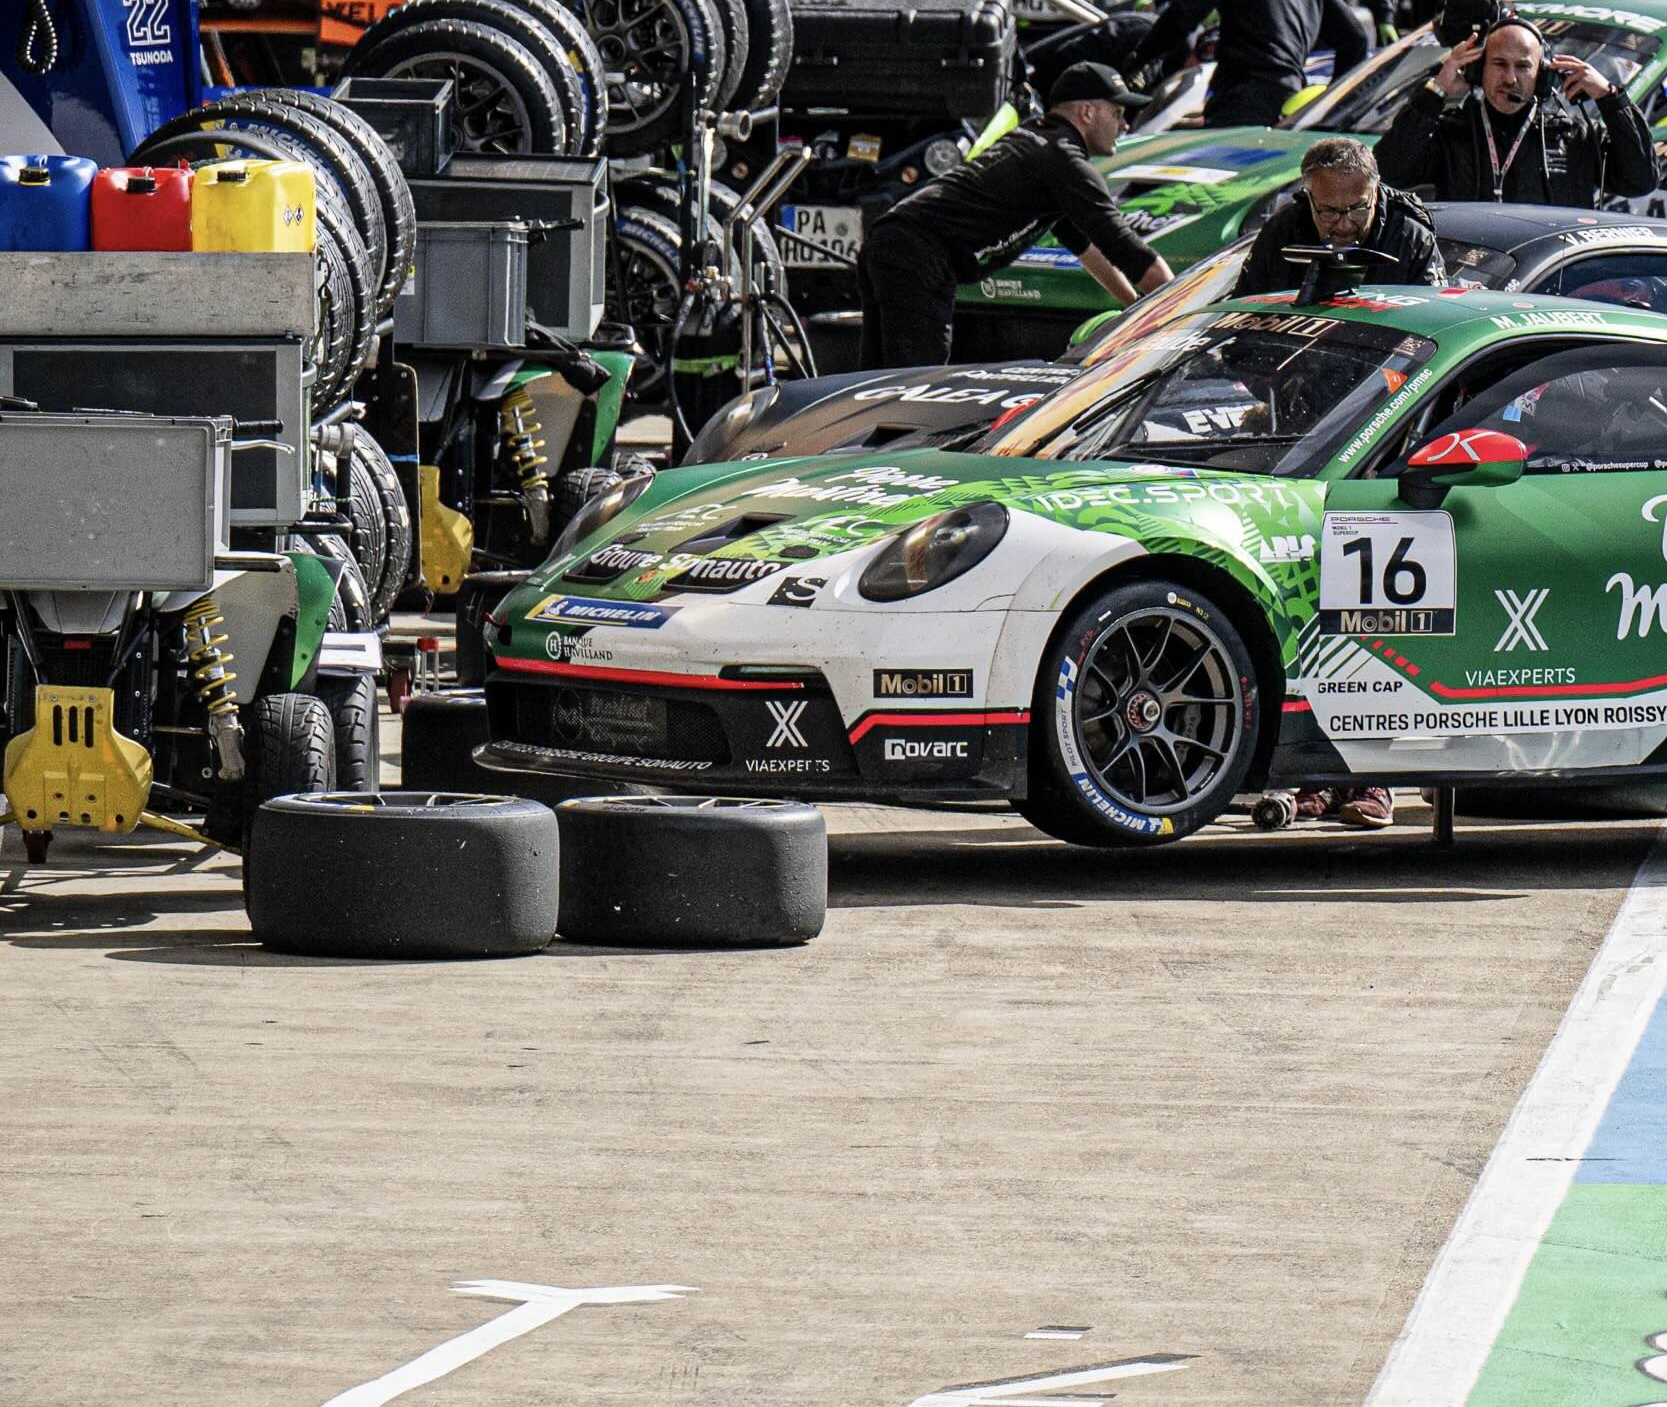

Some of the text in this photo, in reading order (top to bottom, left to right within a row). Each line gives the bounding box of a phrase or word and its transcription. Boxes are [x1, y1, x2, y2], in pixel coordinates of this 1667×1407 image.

[130, 50, 173, 66] TSUNODA
[797, 209, 827, 235] PA
[1208, 312, 1299, 333] Mobil
[1522, 311, 1608, 326] JAUBERT
[1337, 367, 1434, 464] www.porsche.com/pmsc
[1330, 516, 1391, 524] PORSCHE
[658, 552, 782, 580] Sonauto
[1342, 536, 1428, 606] 16
[565, 602, 663, 622] MICHELIN
[1340, 610, 1407, 634] Mobil
[880, 673, 945, 695] Mobil
[1317, 680, 1404, 694] GREEN CAP
[1464, 668, 1577, 688] VIAEXPERTS
[1329, 713, 1410, 733] CENTRES
[1413, 710, 1500, 731] PORSCHE
[1503, 709, 1552, 728] LILLE
[1555, 708, 1600, 727] LYON
[635, 755, 713, 771] SONAUTO
[1077, 776, 1145, 831] MICHELIN
